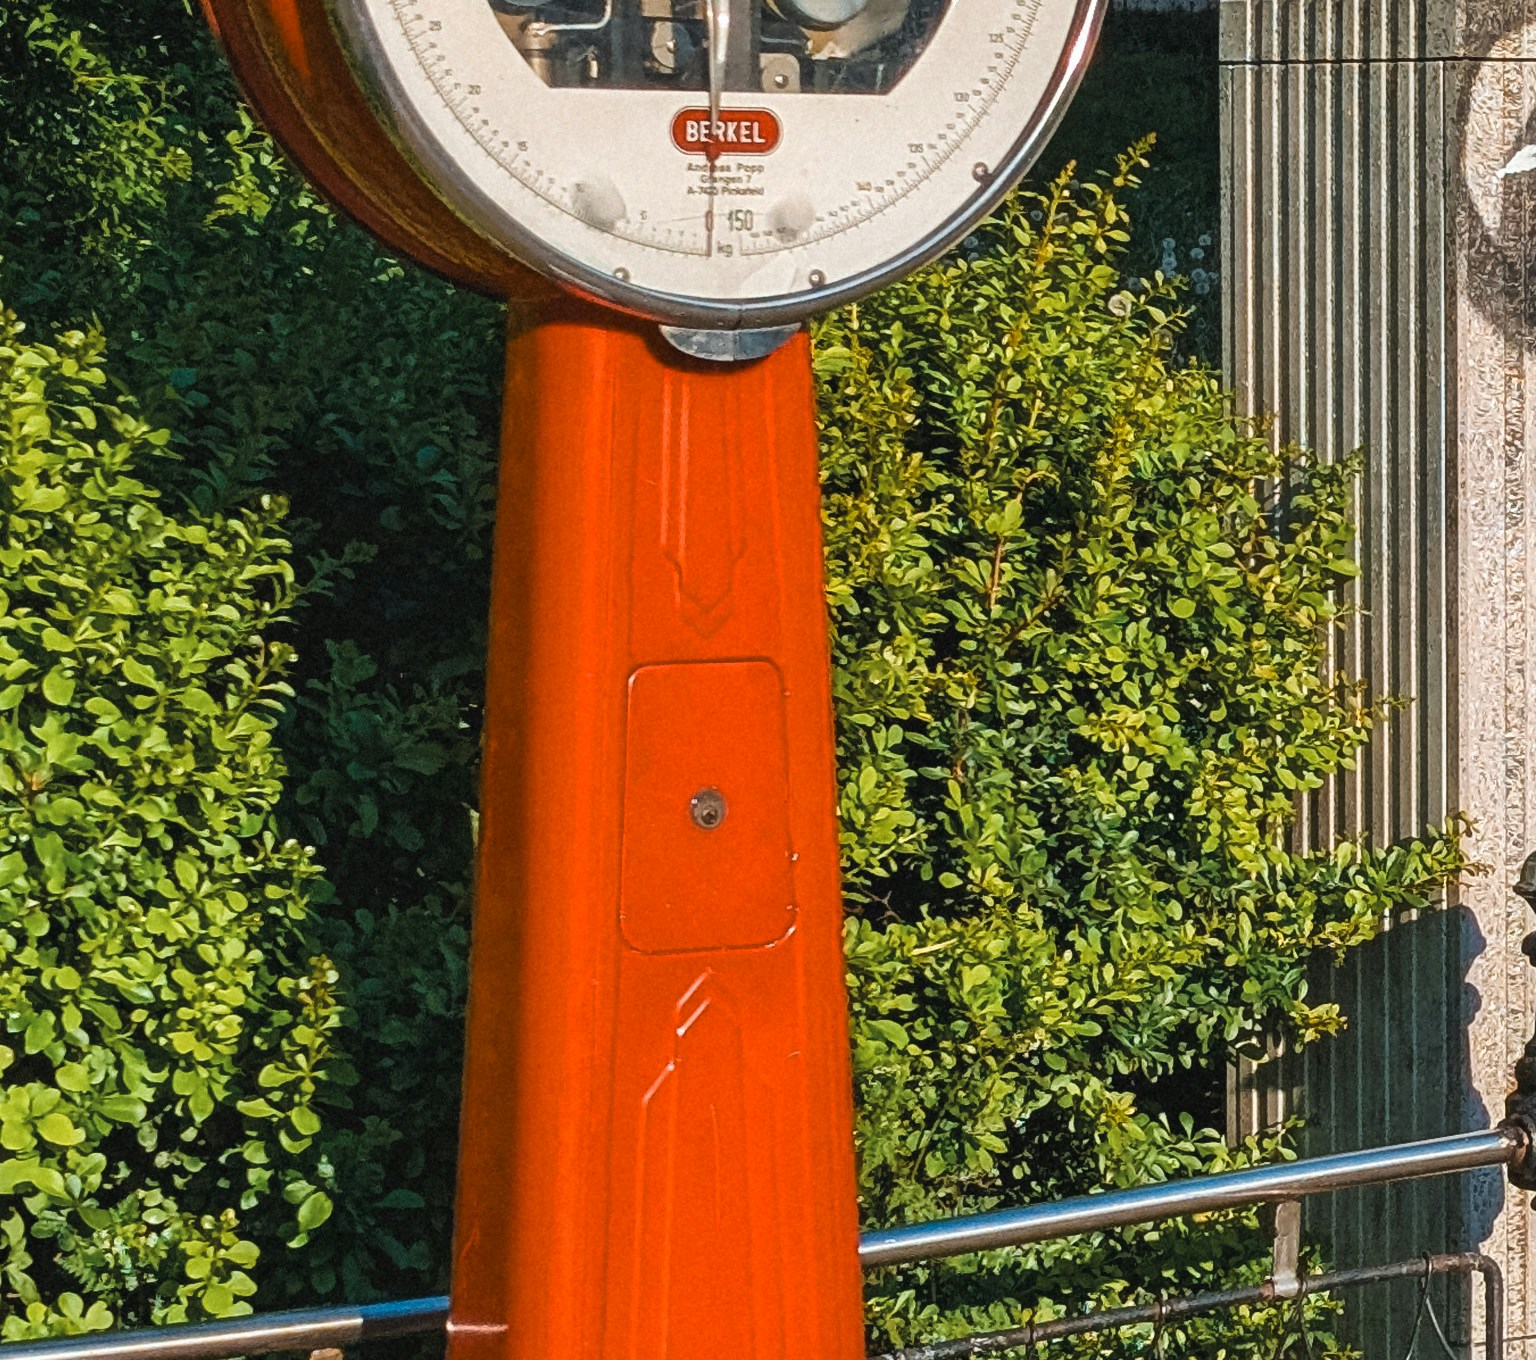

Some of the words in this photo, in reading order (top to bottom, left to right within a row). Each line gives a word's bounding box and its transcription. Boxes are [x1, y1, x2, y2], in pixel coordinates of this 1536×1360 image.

[685, 120, 766, 143] BERKEL
[728, 209, 754, 231] 150
[717, 240, 733, 257] kg
